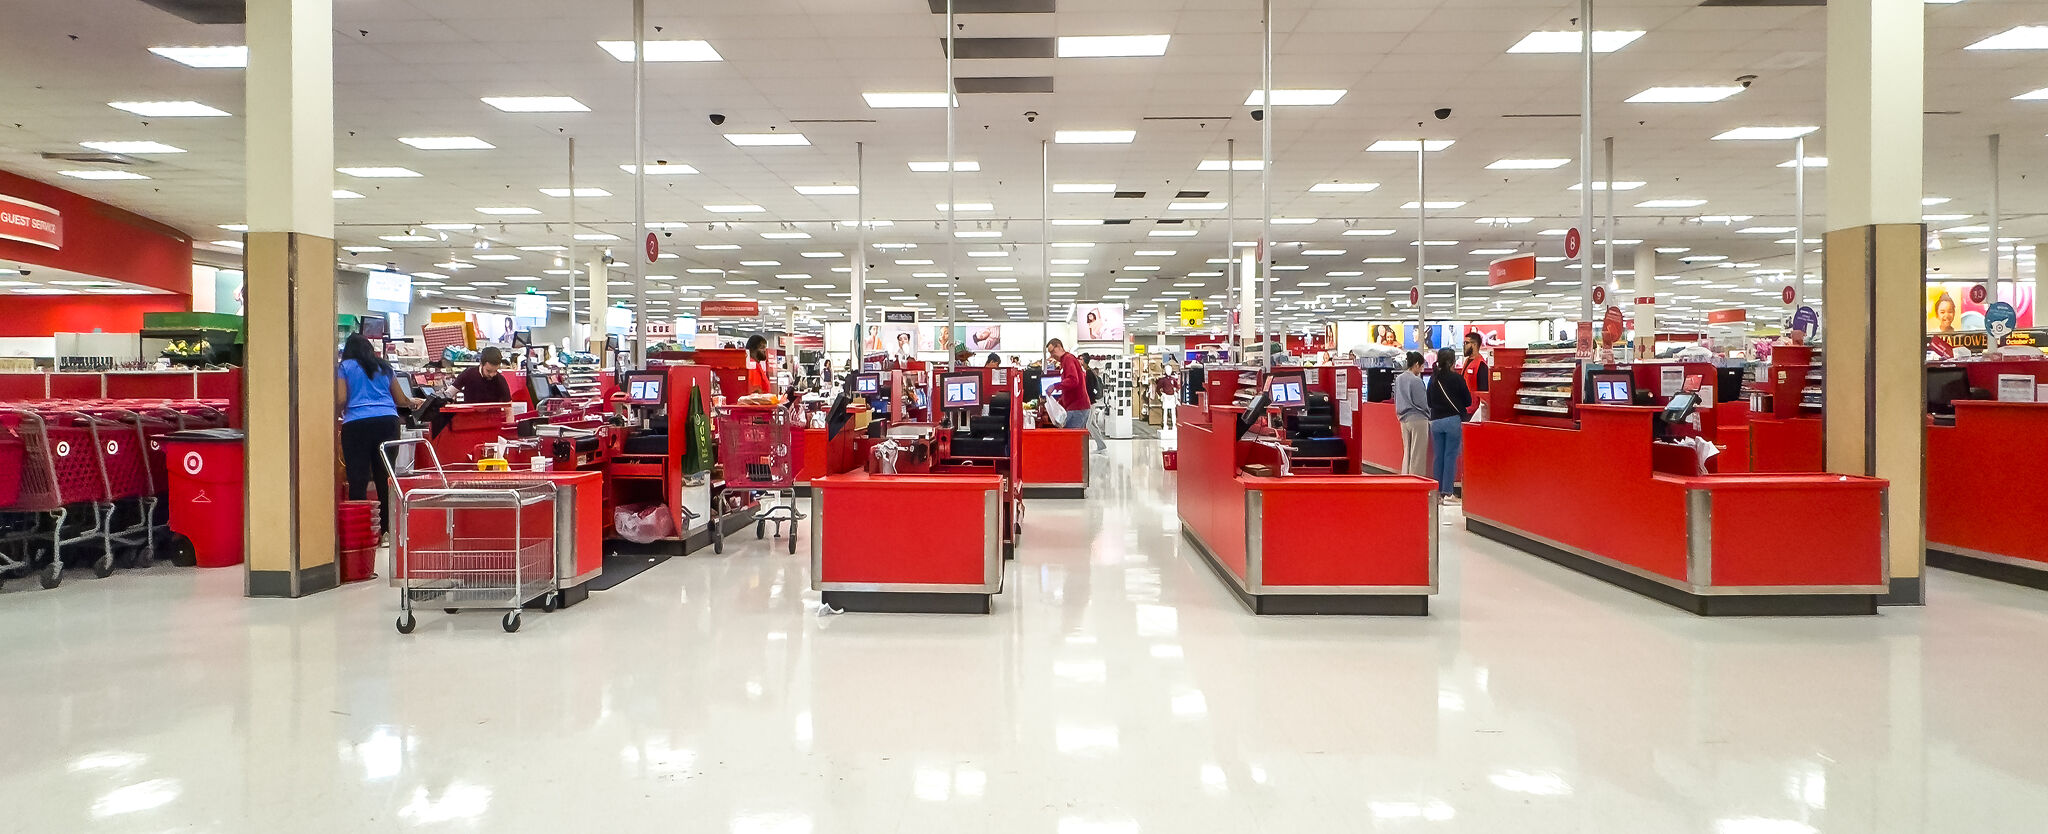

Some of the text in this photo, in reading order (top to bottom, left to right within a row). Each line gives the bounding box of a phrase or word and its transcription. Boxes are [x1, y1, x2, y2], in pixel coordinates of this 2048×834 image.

[0, 212, 30, 227] GUEST
[649, 240, 655, 255] 2
[1570, 236, 1576, 251] 8
[1596, 291, 1602, 300] 9
[1786, 290, 1792, 300] 11
[1974, 289, 1984, 299] 13
